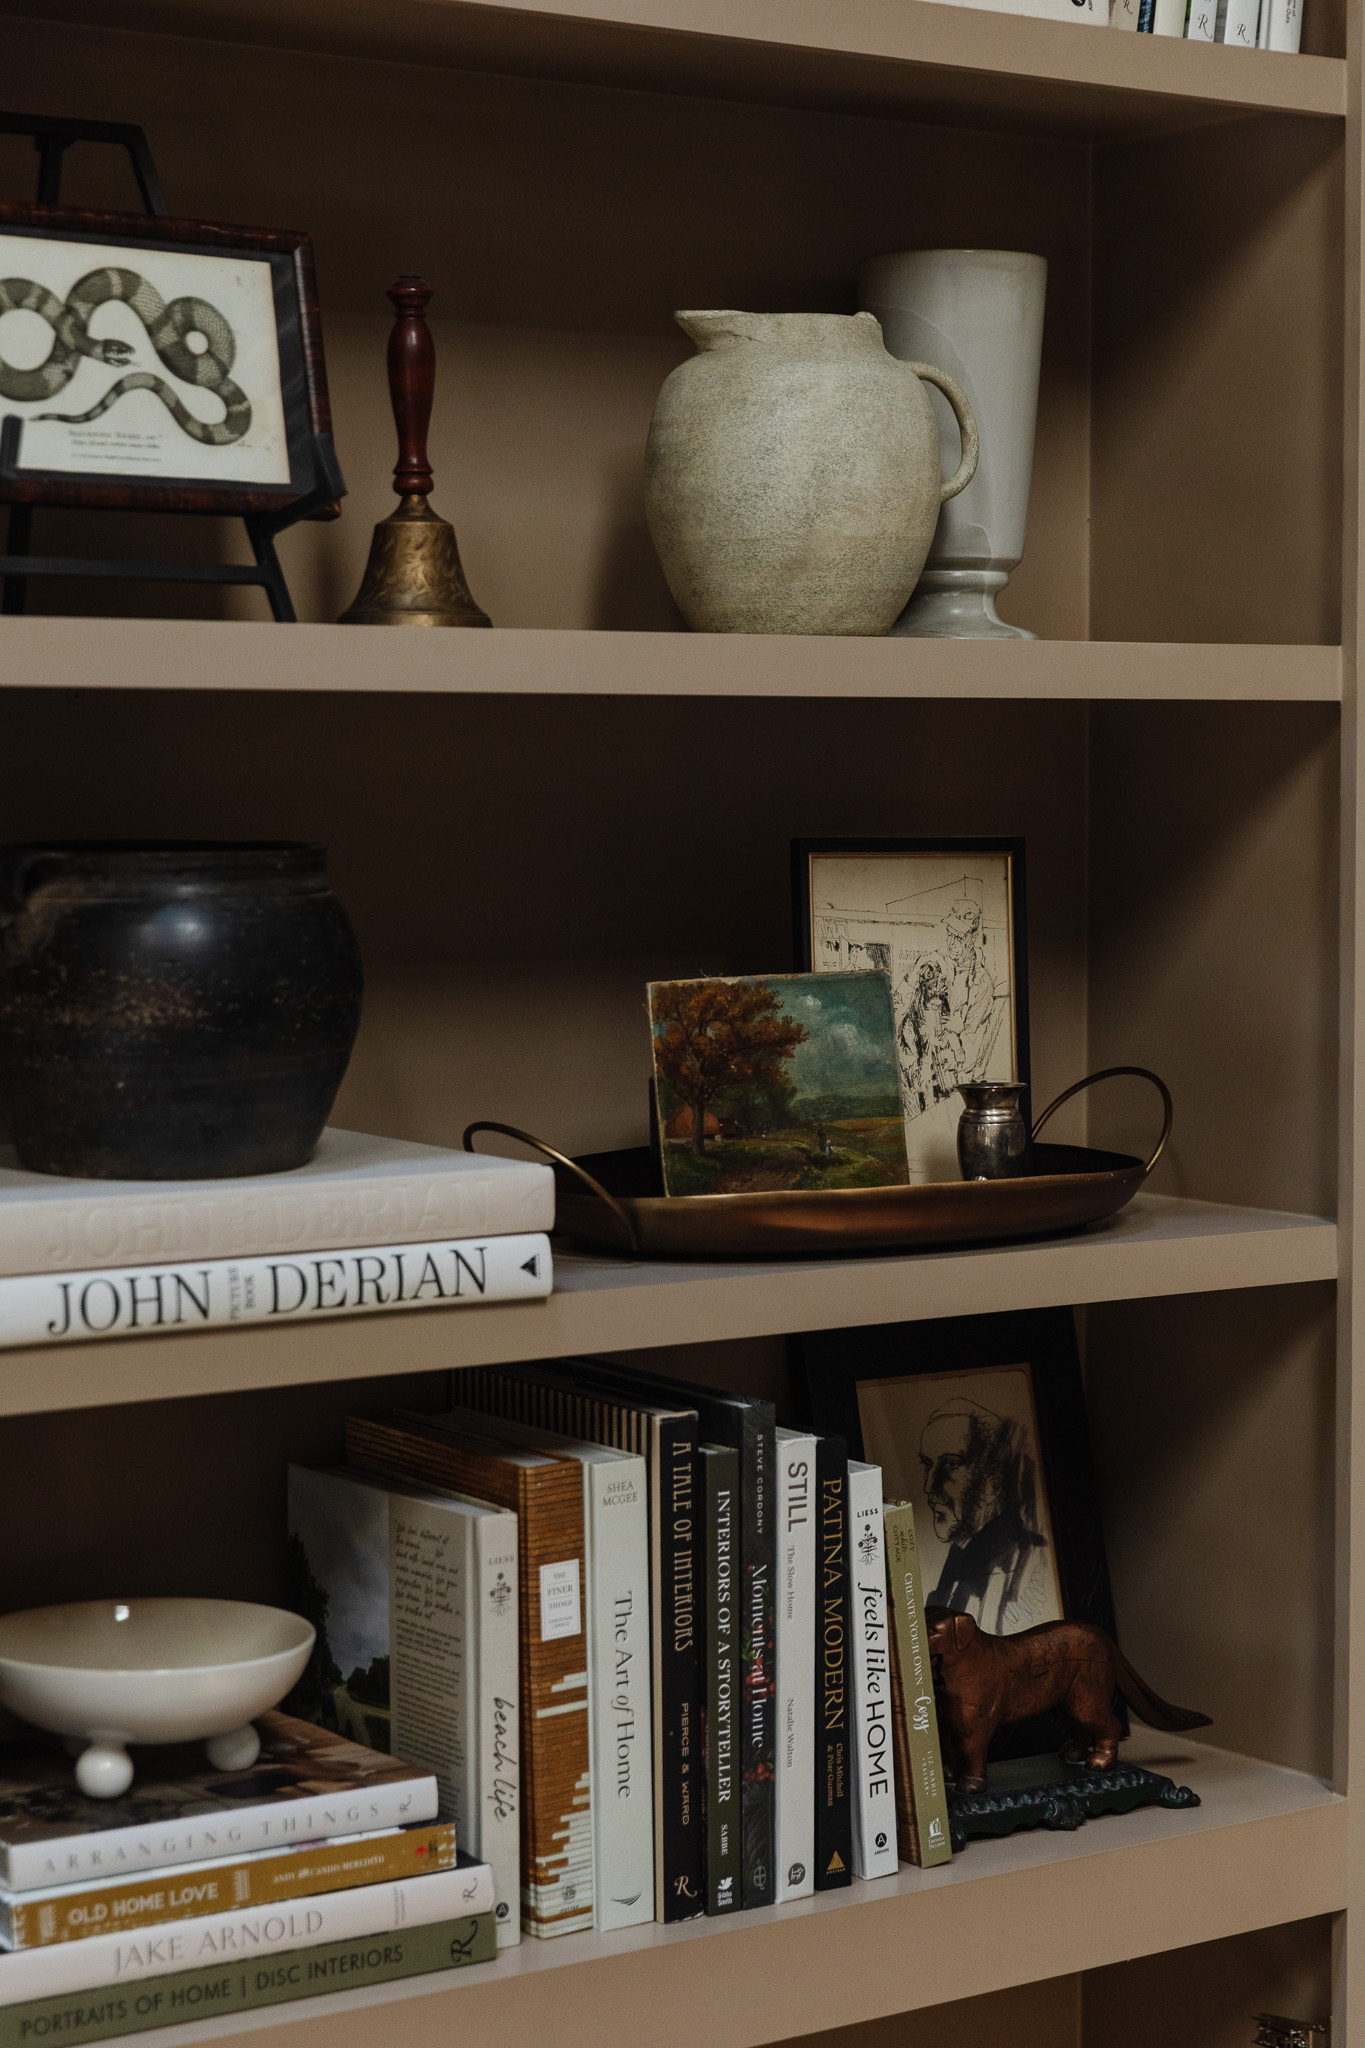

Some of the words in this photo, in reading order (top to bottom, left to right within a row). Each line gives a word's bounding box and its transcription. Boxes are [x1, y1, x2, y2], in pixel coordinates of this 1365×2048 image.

[1197, 13, 1213, 40] R
[1236, 22, 1250, 44] R
[228, 1265, 240, 1321] PICTURE
[245, 1274, 255, 1309] BOOK
[266, 1247, 488, 1315] DERIAN
[47, 1269, 212, 1336] JOHN
[672, 1442, 692, 1456] A
[602, 1492, 639, 1507] MCGEE
[607, 1481, 634, 1494] SHEA
[672, 1463, 692, 1513] TALE
[788, 1461, 809, 1533] STILL
[857, 1507, 879, 1518] LIESS
[673, 1518, 692, 1542] OF
[717, 1490, 731, 1603] INTERIORS
[823, 1477, 843, 1589] PATINA
[907, 1528, 915, 1553] COZY
[489, 1556, 515, 1566] LIESS
[787, 1544, 796, 1565] The
[547, 1584, 574, 1597] FINER
[553, 1570, 567, 1581] THE
[787, 1566, 796, 1591] Slow
[549, 1600, 574, 1610] THINGS
[673, 1550, 694, 1652] INTERIORS
[752, 1564, 768, 1659] Moments
[787, 1591, 795, 1620] Home
[857, 1582, 885, 1642] feels
[904, 1572, 917, 1620] CREATE
[615, 1590, 632, 1643] The
[717, 1607, 731, 1635] OF
[717, 1641, 731, 1653] A
[908, 1620, 921, 1655] YOUR
[616, 1650, 634, 1687] Art
[824, 1595, 844, 1729] MODERN
[866, 1648, 886, 1694] like
[913, 1656, 924, 1686] OWN
[611, 1695, 634, 1716] of
[752, 1687, 767, 1749] Home
[787, 1698, 795, 1732] Natalie
[913, 1690, 932, 1733] Cozy
[493, 1697, 518, 1772] beach
[681, 1702, 689, 1757] PIERCE
[718, 1658, 731, 1803] STORYTELLER
[617, 1721, 635, 1799] Home
[827, 1744, 834, 1752] &
[827, 1753, 835, 1774] Pilar
[836, 1742, 844, 1765] Chris
[866, 1700, 888, 1798] HOME
[682, 1763, 690, 1774] &
[836, 1767, 844, 1799] Mitchell
[487, 1779, 517, 1823] life
[682, 1781, 690, 1826] WARD
[827, 1776, 835, 1807] Guzman
[44, 1826, 242, 1873] ARRANGING
[261, 1803, 379, 1836] THINGS
[720, 1823, 728, 1856] SABBE
[273, 1871, 295, 1884] ANDY
[342, 1855, 385, 1870] MEREDITH
[674, 1875, 698, 1898] R
[67, 1903, 109, 1926] OLD
[112, 1892, 166, 1917] HOME
[168, 1882, 220, 1907] LOVE
[463, 1877, 478, 1903] R
[717, 1890, 733, 1900] Gibbs
[718, 1897, 733, 1907] Smith
[114, 1935, 185, 1977] JAKE
[199, 1910, 323, 1955] ARNOLD
[450, 1919, 478, 1963] R
[20, 1999, 128, 2038] PORTRAITS
[135, 1992, 164, 2016] OF
[171, 1979, 232, 2007] HOME
[255, 1966, 301, 1991] DISC
[308, 1944, 404, 1980] INTERIORS
